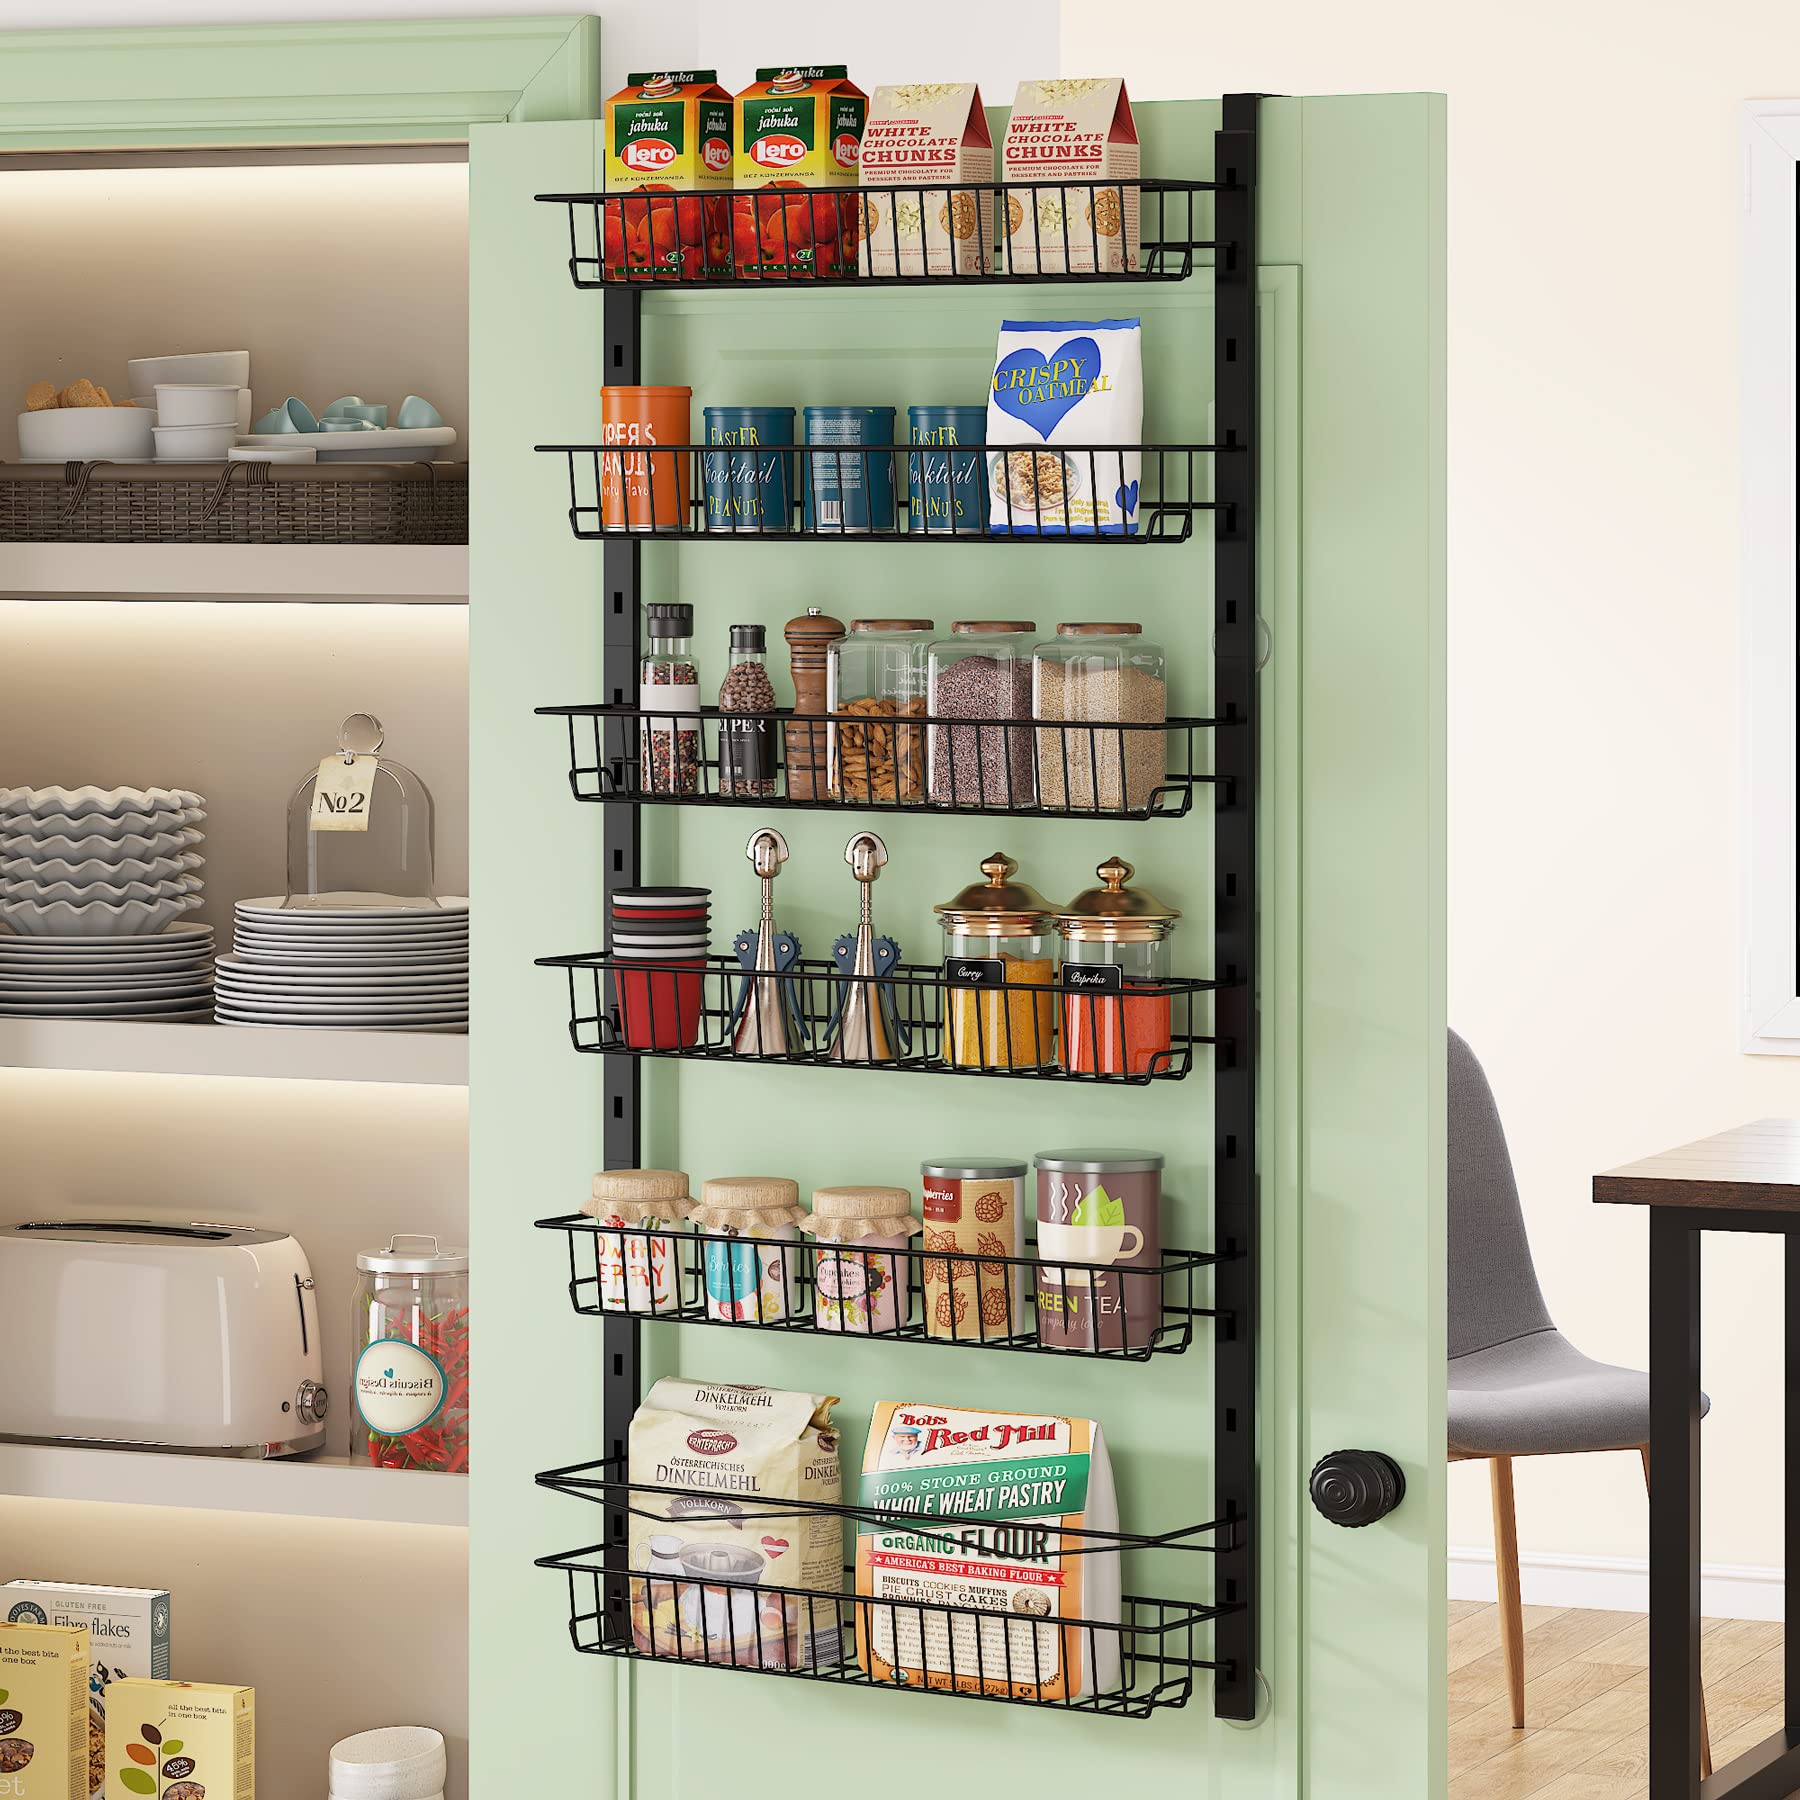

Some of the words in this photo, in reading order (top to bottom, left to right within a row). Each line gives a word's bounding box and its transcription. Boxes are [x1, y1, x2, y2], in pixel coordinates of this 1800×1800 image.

[627, 118, 669, 136] jabuka
[756, 113, 799, 132] jabuka
[867, 126, 932, 138] WHITE
[1011, 122, 1077, 134] WHITE
[863, 137, 958, 148] CHOCOLATE
[1007, 133, 1105, 144] CHOCOLATE
[627, 144, 674, 167] Lero
[705, 142, 730, 165] Lero
[756, 140, 804, 163] Lero
[835, 138, 860, 161] Lero
[862, 148, 956, 163] CHUNKS
[1005, 144, 1103, 159] CHUNKS
[992, 358, 1088, 392] CRISPY
[1018, 374, 1113, 406] OATMEAL
[710, 426, 760, 446] EASTER
[911, 426, 960, 446] EASTER
[956, 966, 984, 981] Curry
[1069, 971, 1107, 987] Paprika
[1037, 1289, 1078, 1314] REEN
[1083, 1295, 1128, 1314] TEA
[695, 1389, 774, 1408] DINKELMEHL
[898, 1412, 948, 1427] Bob's
[920, 1424, 991, 1456] Red
[990, 1422, 1057, 1450] Mill
[670, 1455, 745, 1473] ÖSTERREICHISCHES
[655, 1464, 761, 1492] DINKELMEHL
[873, 1481, 914, 1497] 100%
[919, 1473, 981, 1491] STONE
[987, 1464, 1067, 1484] GROUND
[679, 1499, 733, 1514] VOLLKORN
[872, 1493, 935, 1522] WHOLE
[938, 1487, 996, 1516] WHEAT
[997, 1478, 1068, 1510] PASTRY
[882, 1532, 955, 1555] ORGANIC
[960, 1523, 1050, 1565] FLOUR
[884, 1556, 936, 1571] AMERICA'S
[938, 1562, 966, 1575] BEST
[967, 1566, 1007, 1578] BAKING
[1009, 1569, 1044, 1582] FLOUR
[881, 1583, 902, 1594] PIE
[905, 1586, 953, 1600] CRUST
[958, 1592, 1008, 1607] CAKES
[882, 1575, 920, 1588] BISCUITS
[922, 1580, 967, 1593] COOKIES
[968, 1585, 1008, 1597] MUFFINS
[55, 1601, 85, 1609] GLUTEN
[87, 1603, 107, 1611] FREE
[91, 1617, 130, 1638] flakes
[4, 1647, 20, 1656] the
[21, 1647, 41, 1657] best
[42, 1648, 59, 1658] bits
[20, 1657, 37, 1665] box
[917, 1675, 934, 1685] NT
[934, 1678, 948, 1687] WT
[956, 1680, 973, 1690] LBS
